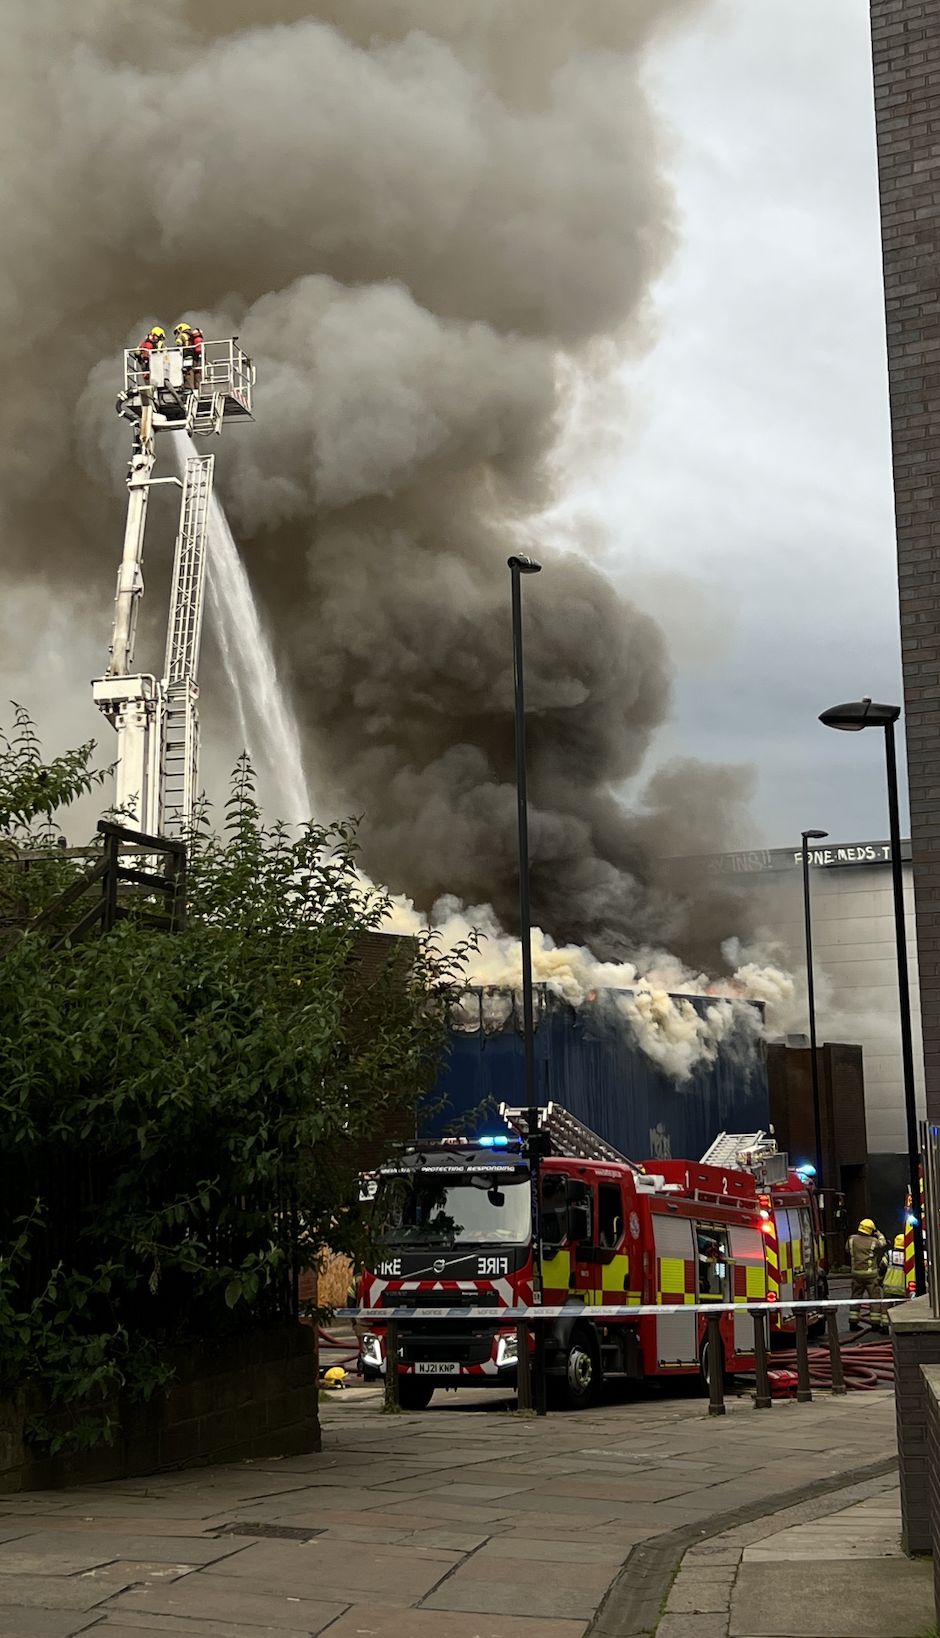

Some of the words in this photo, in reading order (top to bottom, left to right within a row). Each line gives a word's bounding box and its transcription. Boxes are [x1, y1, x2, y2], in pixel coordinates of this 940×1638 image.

[466, 1165, 515, 1173] RESPONDING
[684, 1170, 690, 1189] 1
[722, 1176, 729, 1195] 2
[419, 1363, 438, 1373] NJ21
[439, 1363, 455, 1373] KNP
